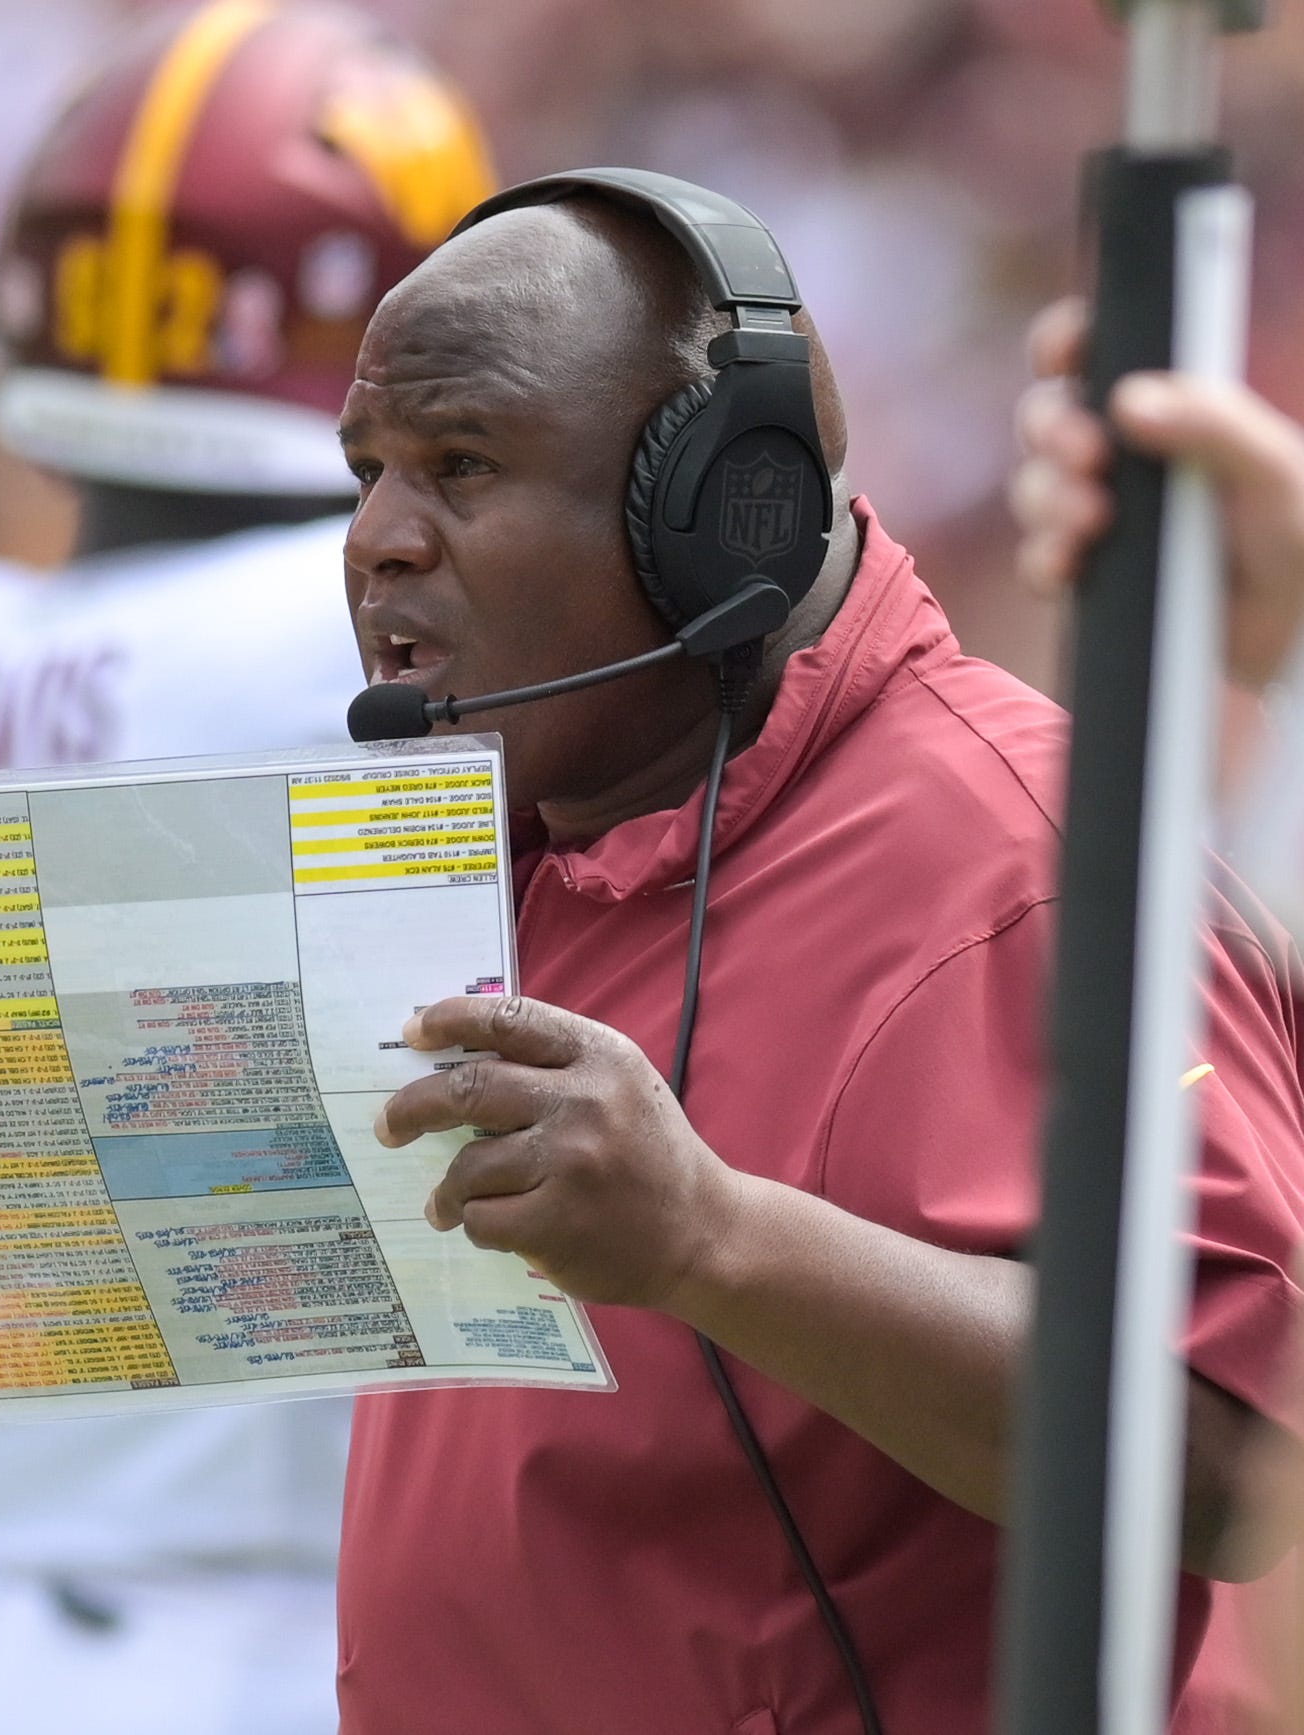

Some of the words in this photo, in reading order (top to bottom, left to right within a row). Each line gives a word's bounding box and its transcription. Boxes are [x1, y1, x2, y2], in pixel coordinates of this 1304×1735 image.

[728, 503, 787, 549] NFL
[427, 766, 460, 775] OFFICIAL
[461, 764, 490, 773] REPLAY
[360, 771, 391, 779] CRUDUP
[393, 769, 420, 777] DENISE
[290, 776, 302, 784] AM
[303, 775, 322, 783] 11:37
[470, 778, 491, 786] BACK
[401, 782, 424, 791] GREG
[443, 779, 469, 788] JUDGE
[375, 784, 400, 792] MEYER
[404, 796, 424, 804] DALE
[448, 793, 474, 801] JUDGE
[475, 792, 491, 800] SIDE
[380, 798, 403, 806] SHAW
[400, 810, 421, 818] JOHN
[421, 809, 438, 817] #117
[445, 807, 470, 816] JUDGE
[471, 806, 492, 814] FIELD
[368, 812, 399, 820] JENKINS
[402, 824, 426, 832] ROBIN
[451, 821, 475, 829] JUDGE
[356, 825, 401, 835] DELORENZO
[397, 838, 424, 846] DERICK
[445, 835, 470, 843] JUDGE
[363, 840, 395, 849] BOWERS
[467, 847, 494, 855] UMPIRE
[381, 851, 425, 862] SLAUGHTER
[462, 861, 495, 870] REFEREE
[403, 866, 419, 874] ECK
[447, 874, 471, 882] CREW:
[472, 873, 496, 881] ALLEN
